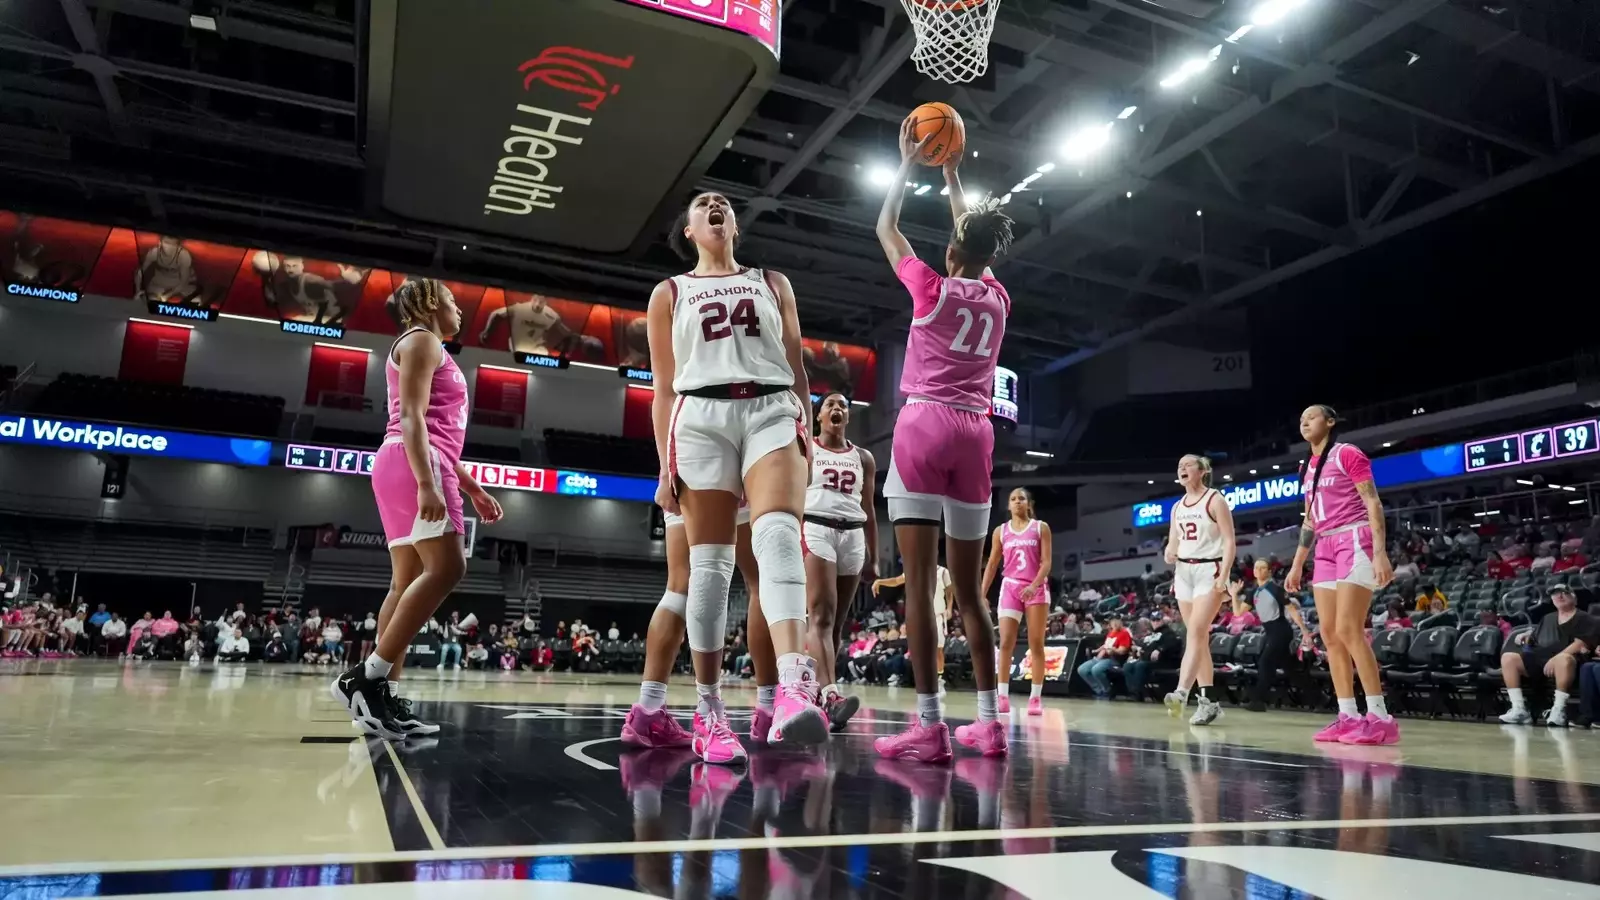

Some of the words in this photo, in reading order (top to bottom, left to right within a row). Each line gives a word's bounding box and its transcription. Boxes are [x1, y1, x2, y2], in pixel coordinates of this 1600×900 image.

[484, 103, 593, 215] Health
[7, 283, 78, 302] CHAMPIONS
[688, 286, 763, 305] OKLAHOMA
[158, 304, 209, 320] TWYMAN
[698, 298, 761, 342] 24
[283, 321, 342, 338] ROBERTSON
[949, 307, 994, 357] 22
[525, 355, 559, 367] MARTIN
[1212, 355, 1244, 372] 201
[0, 417, 26, 438] al
[32, 419, 168, 451] Workplace
[1564, 426, 1588, 451] 39
[1470, 445, 1486, 454] TOL
[1502, 439, 1510, 450] 4
[816, 460, 860, 471] OKLAHOMA
[1471, 457, 1486, 467] FLS
[1503, 451, 1511, 462] 0
[106, 483, 120, 494] 121
[565, 472, 597, 489] cbts
[822, 468, 857, 494] 32
[1220, 482, 1262, 511] gital
[1138, 504, 1162, 518] cbts
[1179, 522, 1198, 541] 12
[1015, 549, 1027, 571] 3
